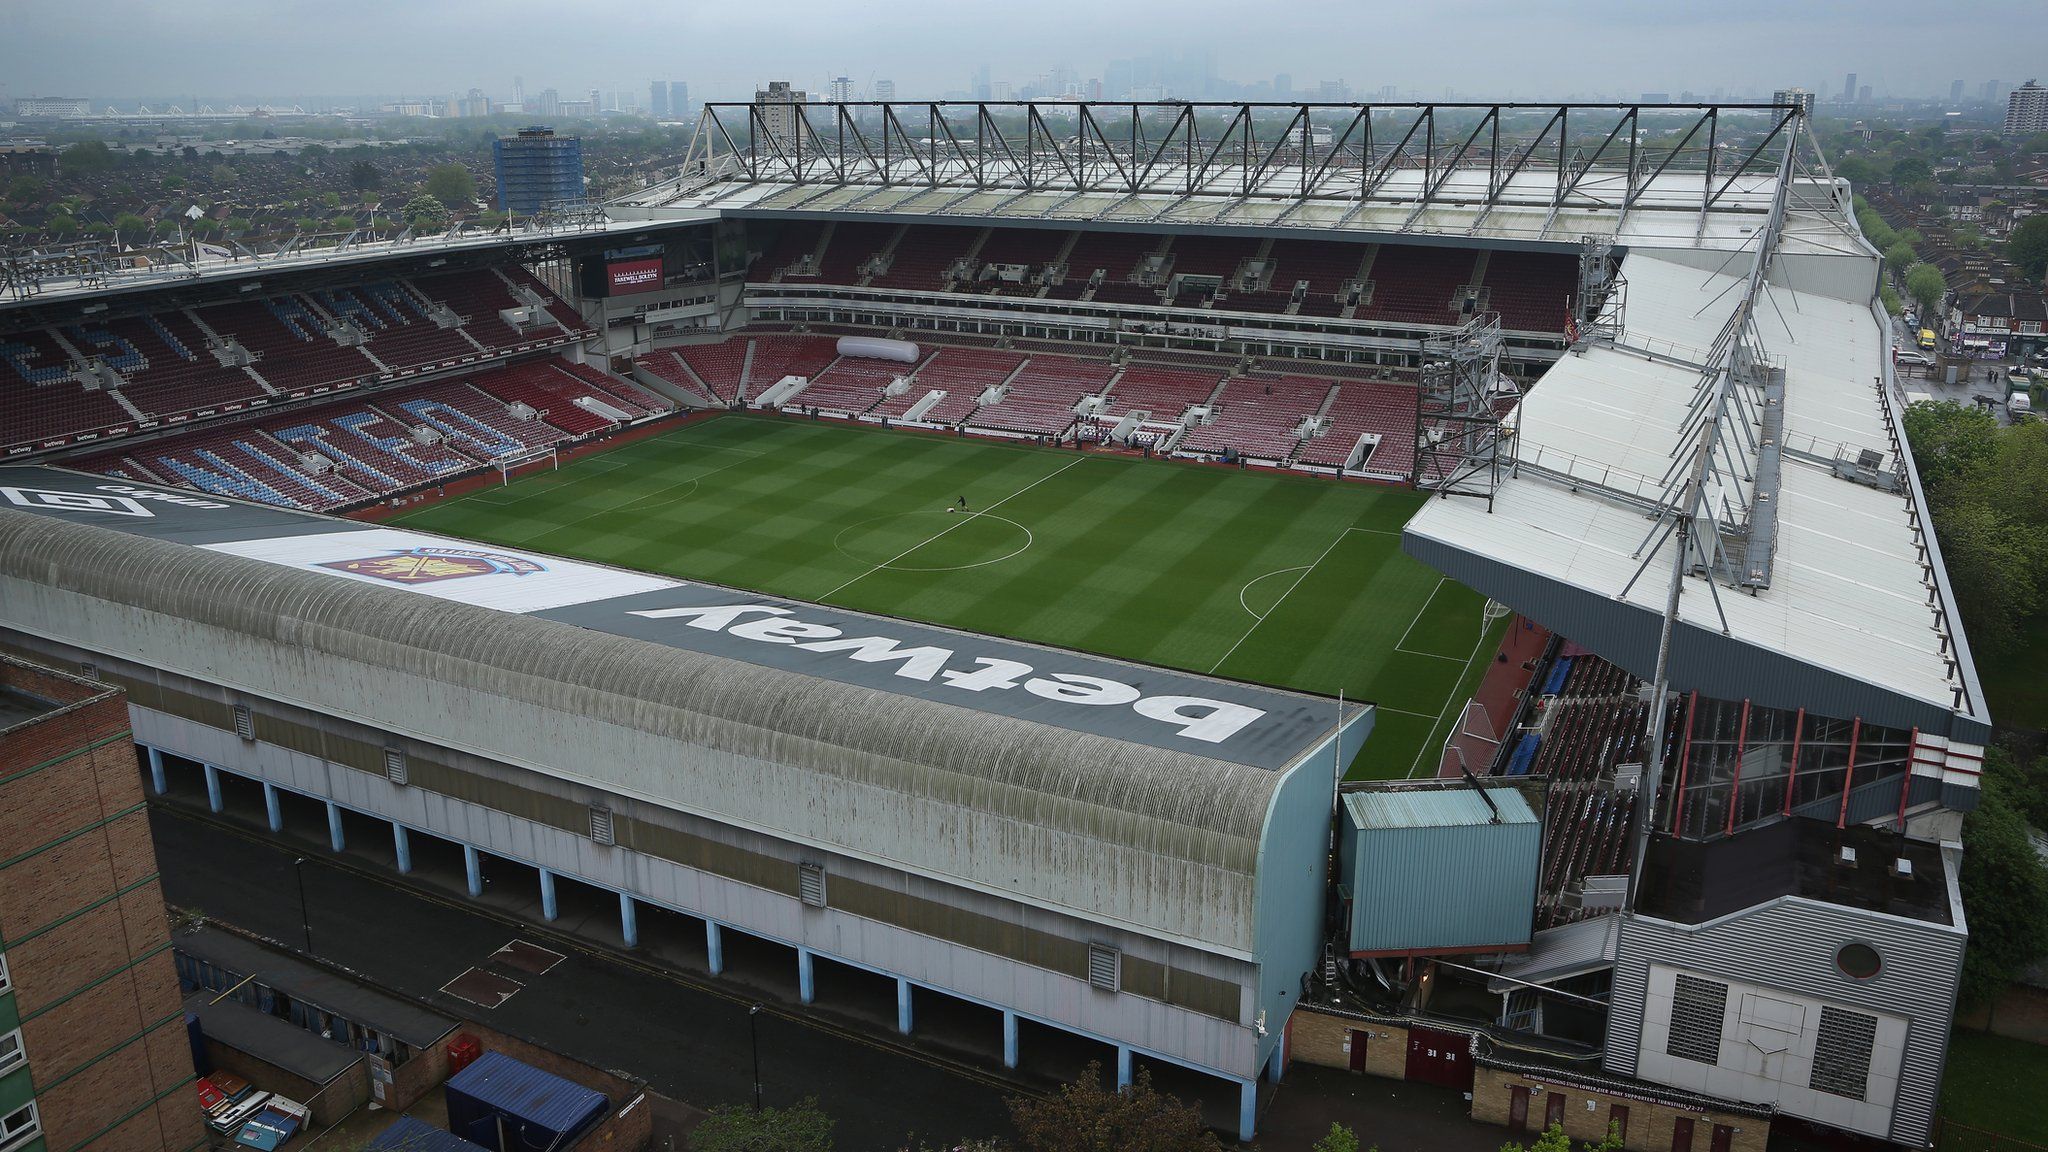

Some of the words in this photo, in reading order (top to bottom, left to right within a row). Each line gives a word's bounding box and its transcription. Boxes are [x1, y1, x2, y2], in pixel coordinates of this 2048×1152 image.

[224, 404, 242, 412] betway
[184, 417, 237, 432] GREENWOOD
[240, 412, 256, 420] AND
[258, 408, 279, 417] LYALL
[282, 402, 312, 412] LOUNGE
[77, 433, 97, 441] betway
[10, 446, 31, 454] betway
[625, 604, 1267, 744] betway
[1428, 1048, 1437, 1058] 31
[1445, 1052, 1456, 1061] 31
[1580, 1084, 1597, 1092] LOWER
[1624, 1093, 1656, 1103] SUPPORTERS
[1658, 1099, 1686, 1108] TURNSTILES
